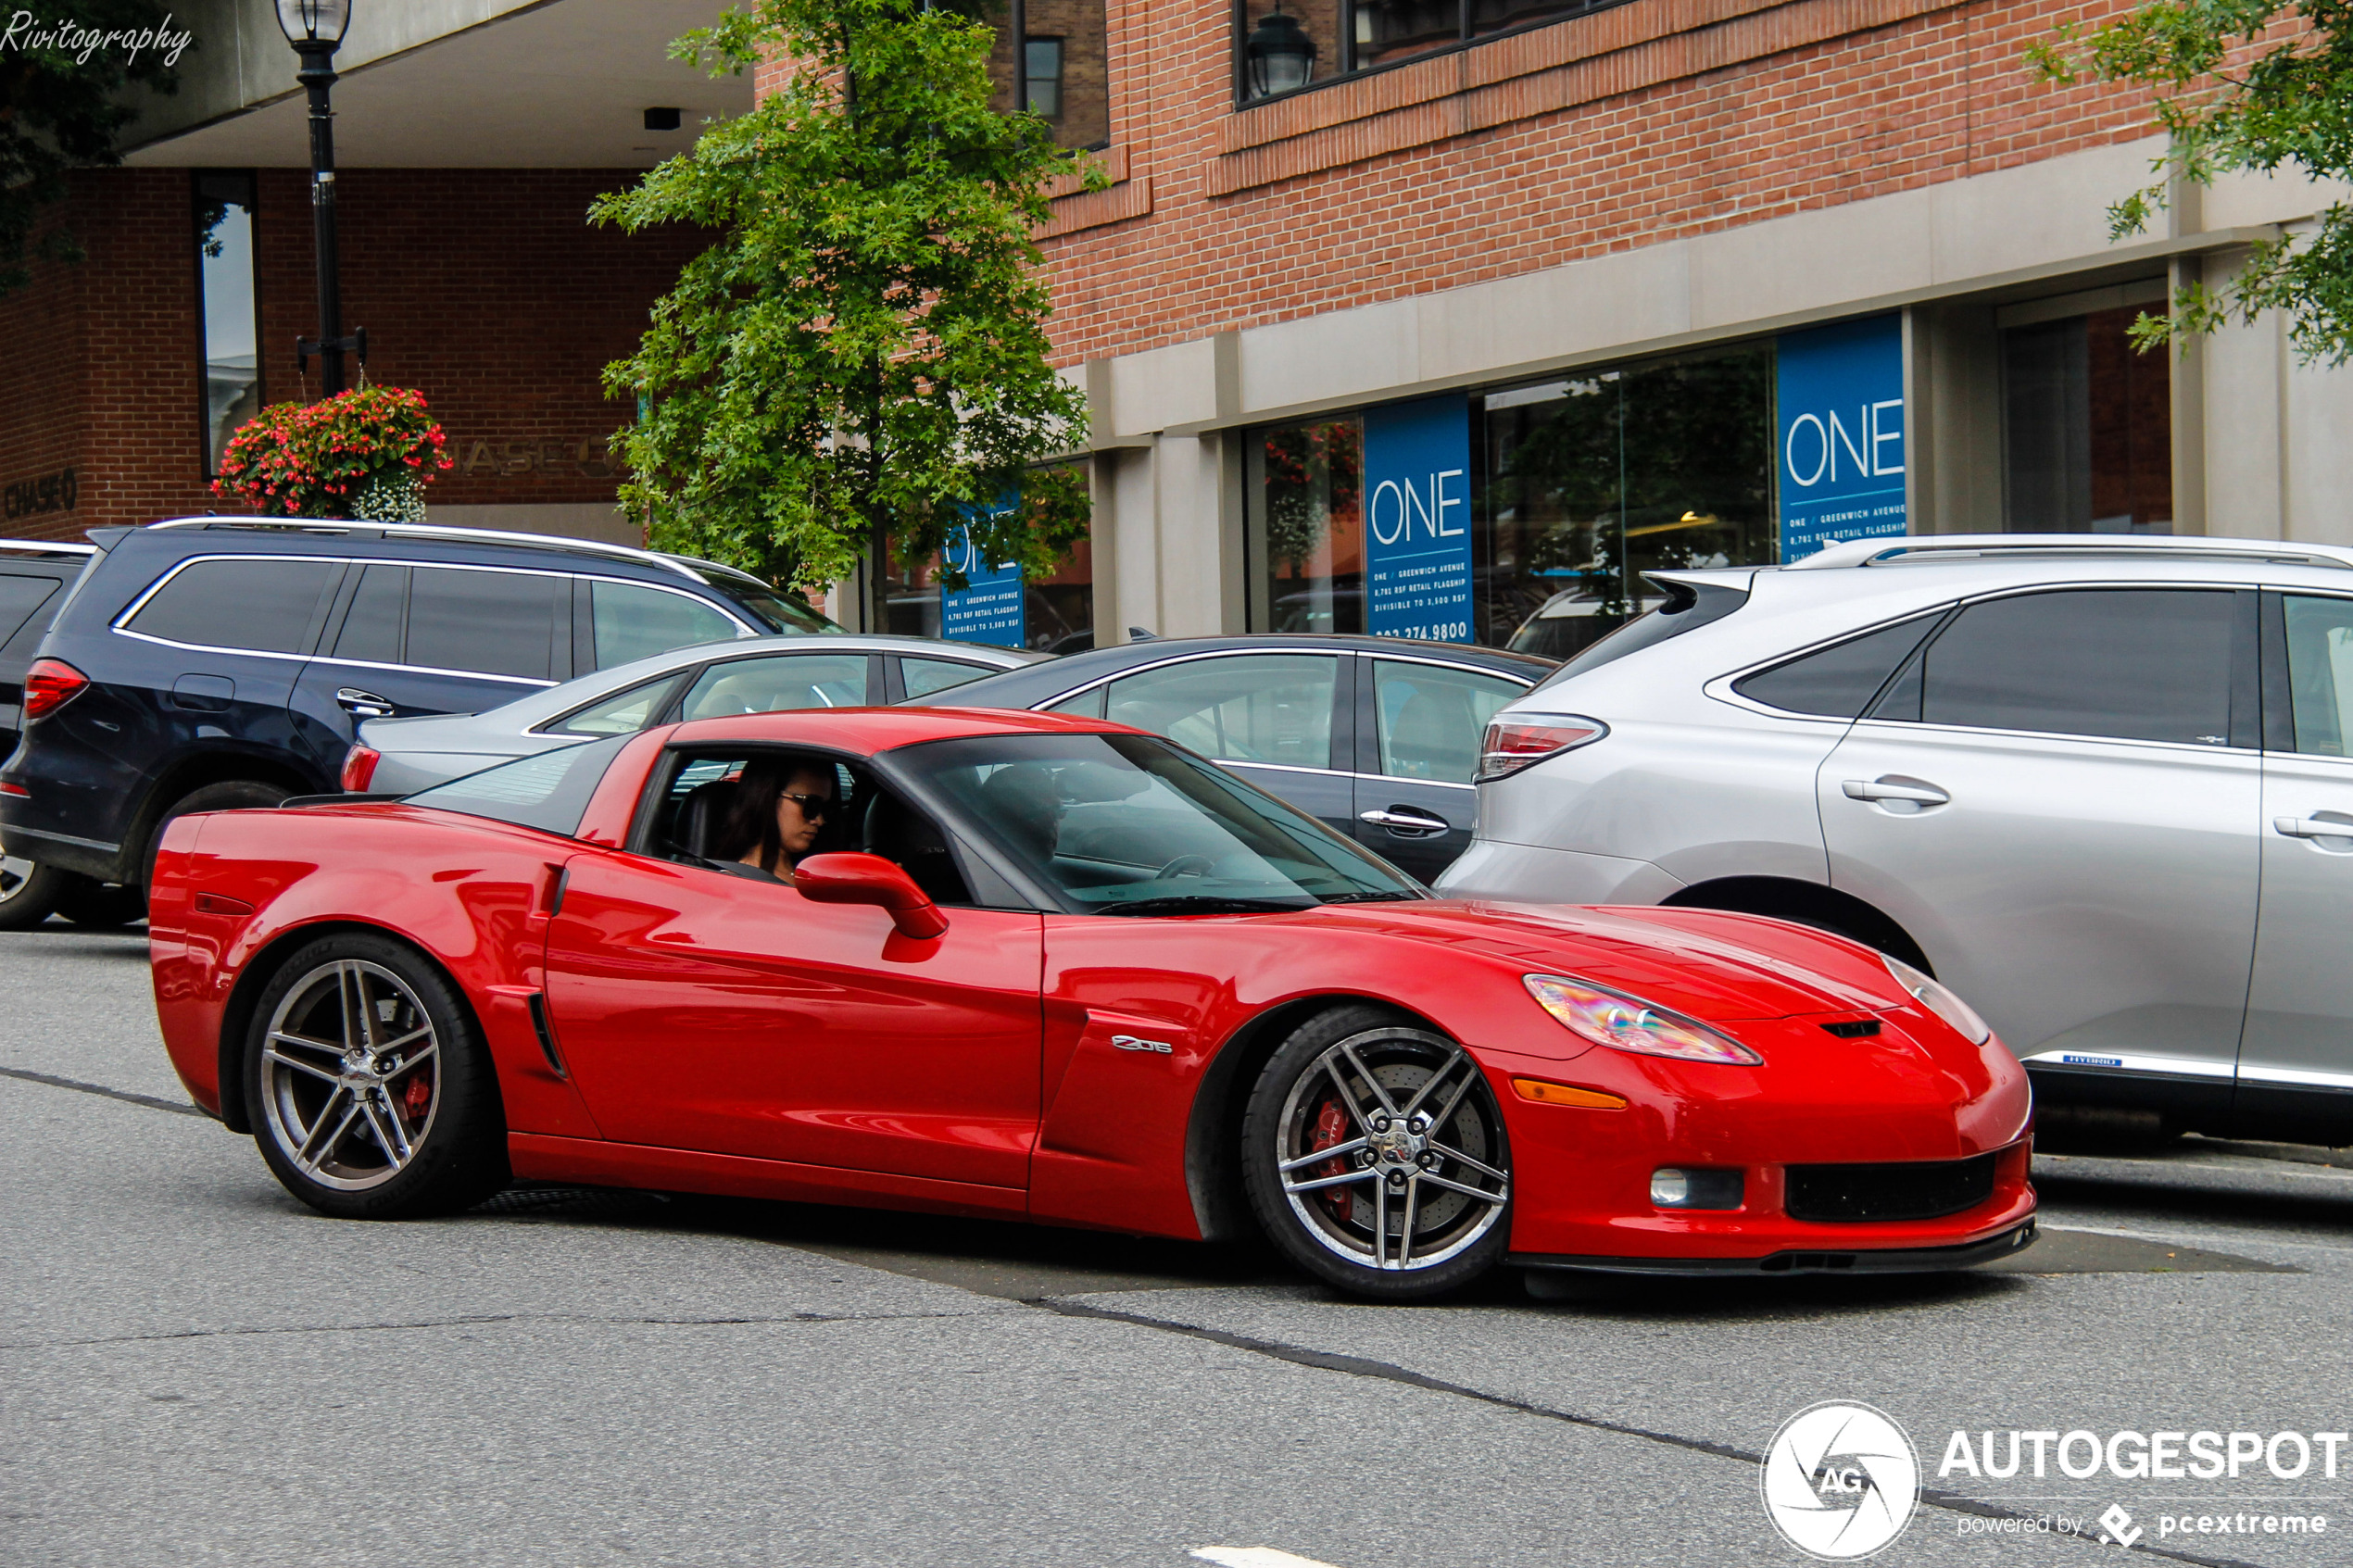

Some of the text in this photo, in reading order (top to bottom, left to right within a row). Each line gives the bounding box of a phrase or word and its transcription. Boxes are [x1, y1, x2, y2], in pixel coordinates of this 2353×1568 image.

[1786, 398, 1906, 486] ONE
[5, 475, 61, 518] CHASE
[1371, 469, 1465, 545] ONE
[1790, 518, 1806, 528] ONE
[1820, 509, 1869, 523] GREENWICH
[1873, 504, 1906, 517] AVENUE
[1833, 528, 1862, 539] RETAIL
[1866, 522, 1906, 534] FLAGSHIP
[1374, 572, 1387, 581] ONE
[1398, 566, 1437, 578] GREENWICH
[1439, 562, 1465, 572] AVENUE
[1394, 585, 1406, 594] RSF
[1408, 583, 1431, 592] RETAIL
[1433, 578, 1466, 589] FLAGSHIP
[948, 599, 958, 608] ONE
[966, 595, 996, 605] GREENWICH
[998, 591, 1018, 600] AVENUE
[1375, 600, 1411, 612] DIVISIBLE
[1428, 596, 1449, 607] 3,500
[1452, 594, 1466, 603] RSF
[975, 608, 992, 618] RETAIL
[994, 605, 1018, 615] FLAGSHIP
[949, 624, 976, 634] DIVISIBLE
[1112, 1035, 1173, 1053] Z06
[2070, 1056, 2116, 1065] HYBRID
